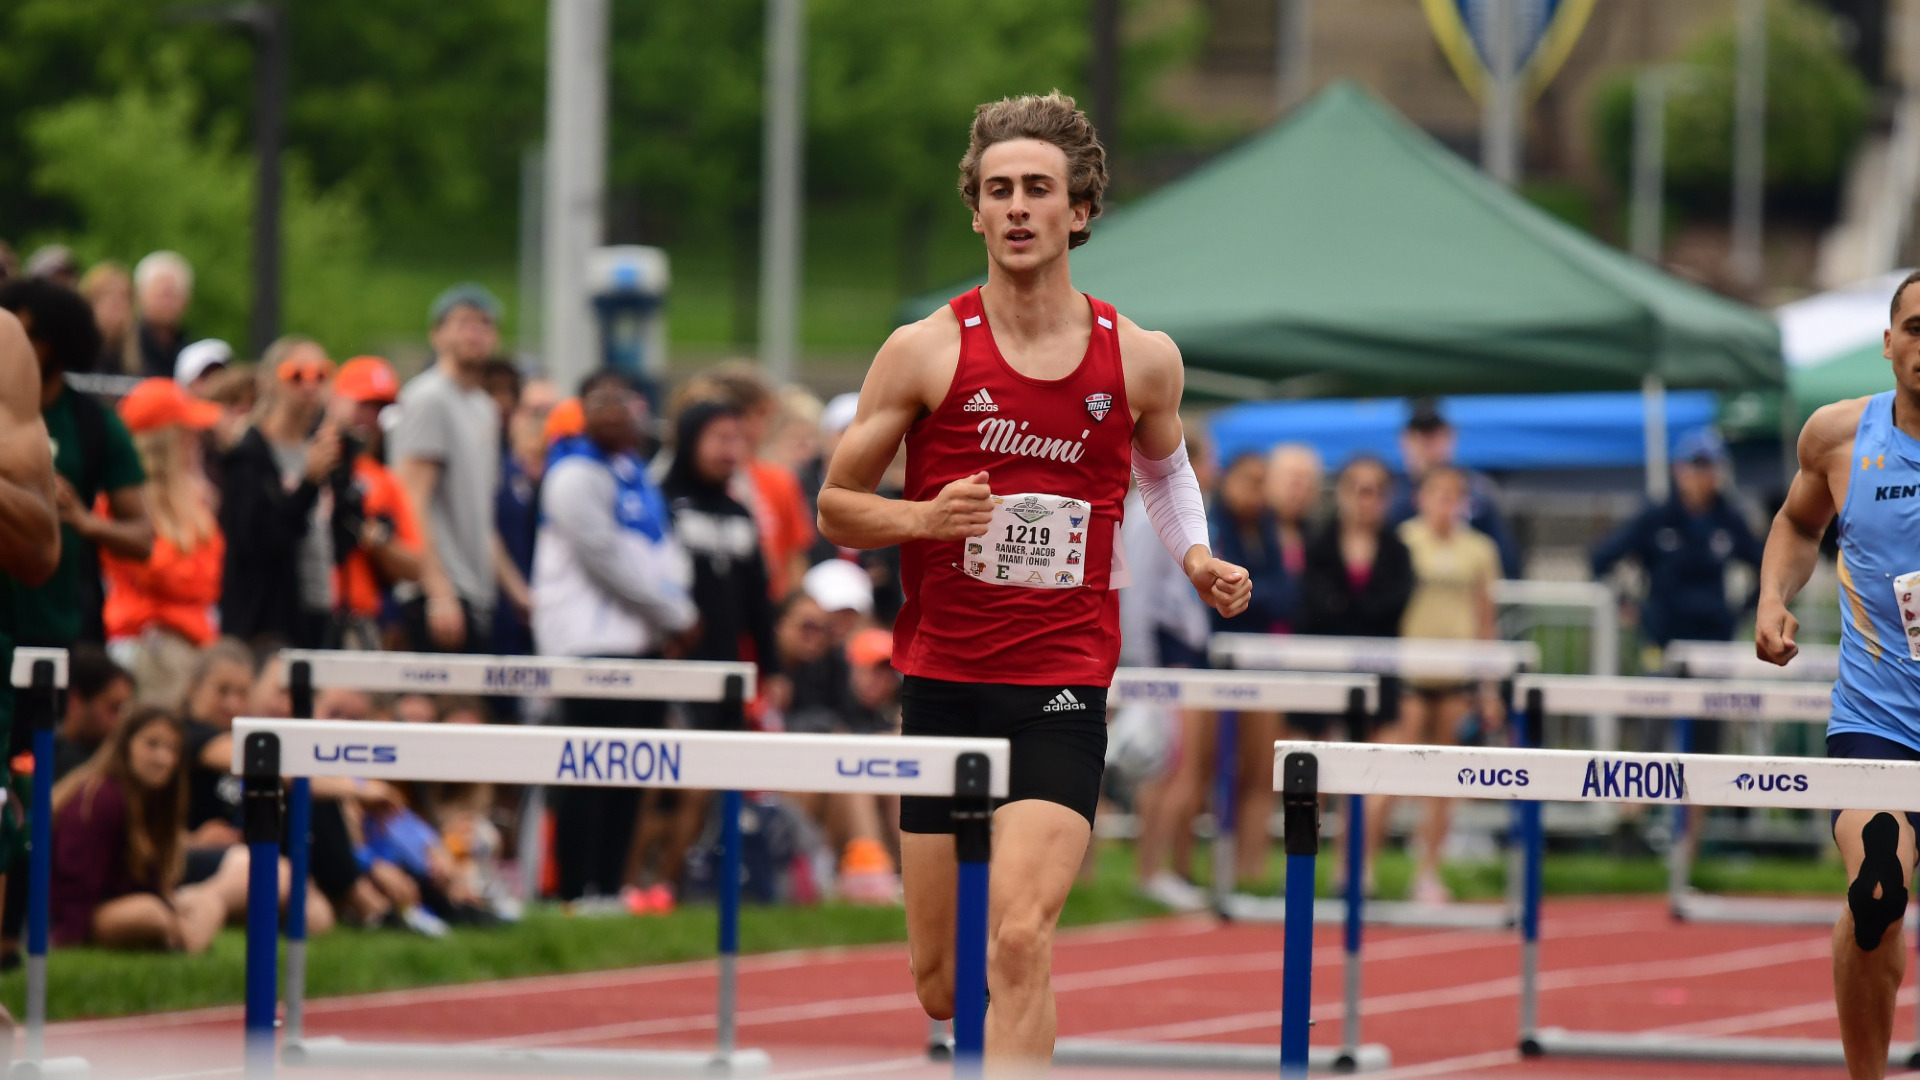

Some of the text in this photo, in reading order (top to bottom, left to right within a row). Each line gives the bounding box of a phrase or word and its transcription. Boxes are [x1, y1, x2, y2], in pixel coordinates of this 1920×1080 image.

[963, 403, 999, 412] adidas
[1087, 400, 1111, 411] MAC
[977, 417, 1090, 464] Miami
[1875, 484, 1920, 501] KEN
[1004, 524, 1050, 546] 1219
[1069, 532, 1081, 543] M
[995, 543, 1056, 557] RANKER, JACOB
[998, 554, 1050, 567] MIAMI (OHIO)
[996, 565, 1009, 579] E
[1024, 570, 1045, 583] A
[1043, 701, 1086, 711] adidas
[314, 744, 397, 763] UCS
[556, 740, 681, 782] AKRON
[837, 758, 919, 777] UCS
[1479, 768, 1530, 787] UCS
[1581, 757, 1684, 799] AKRON
[1758, 774, 1808, 792] UCS
